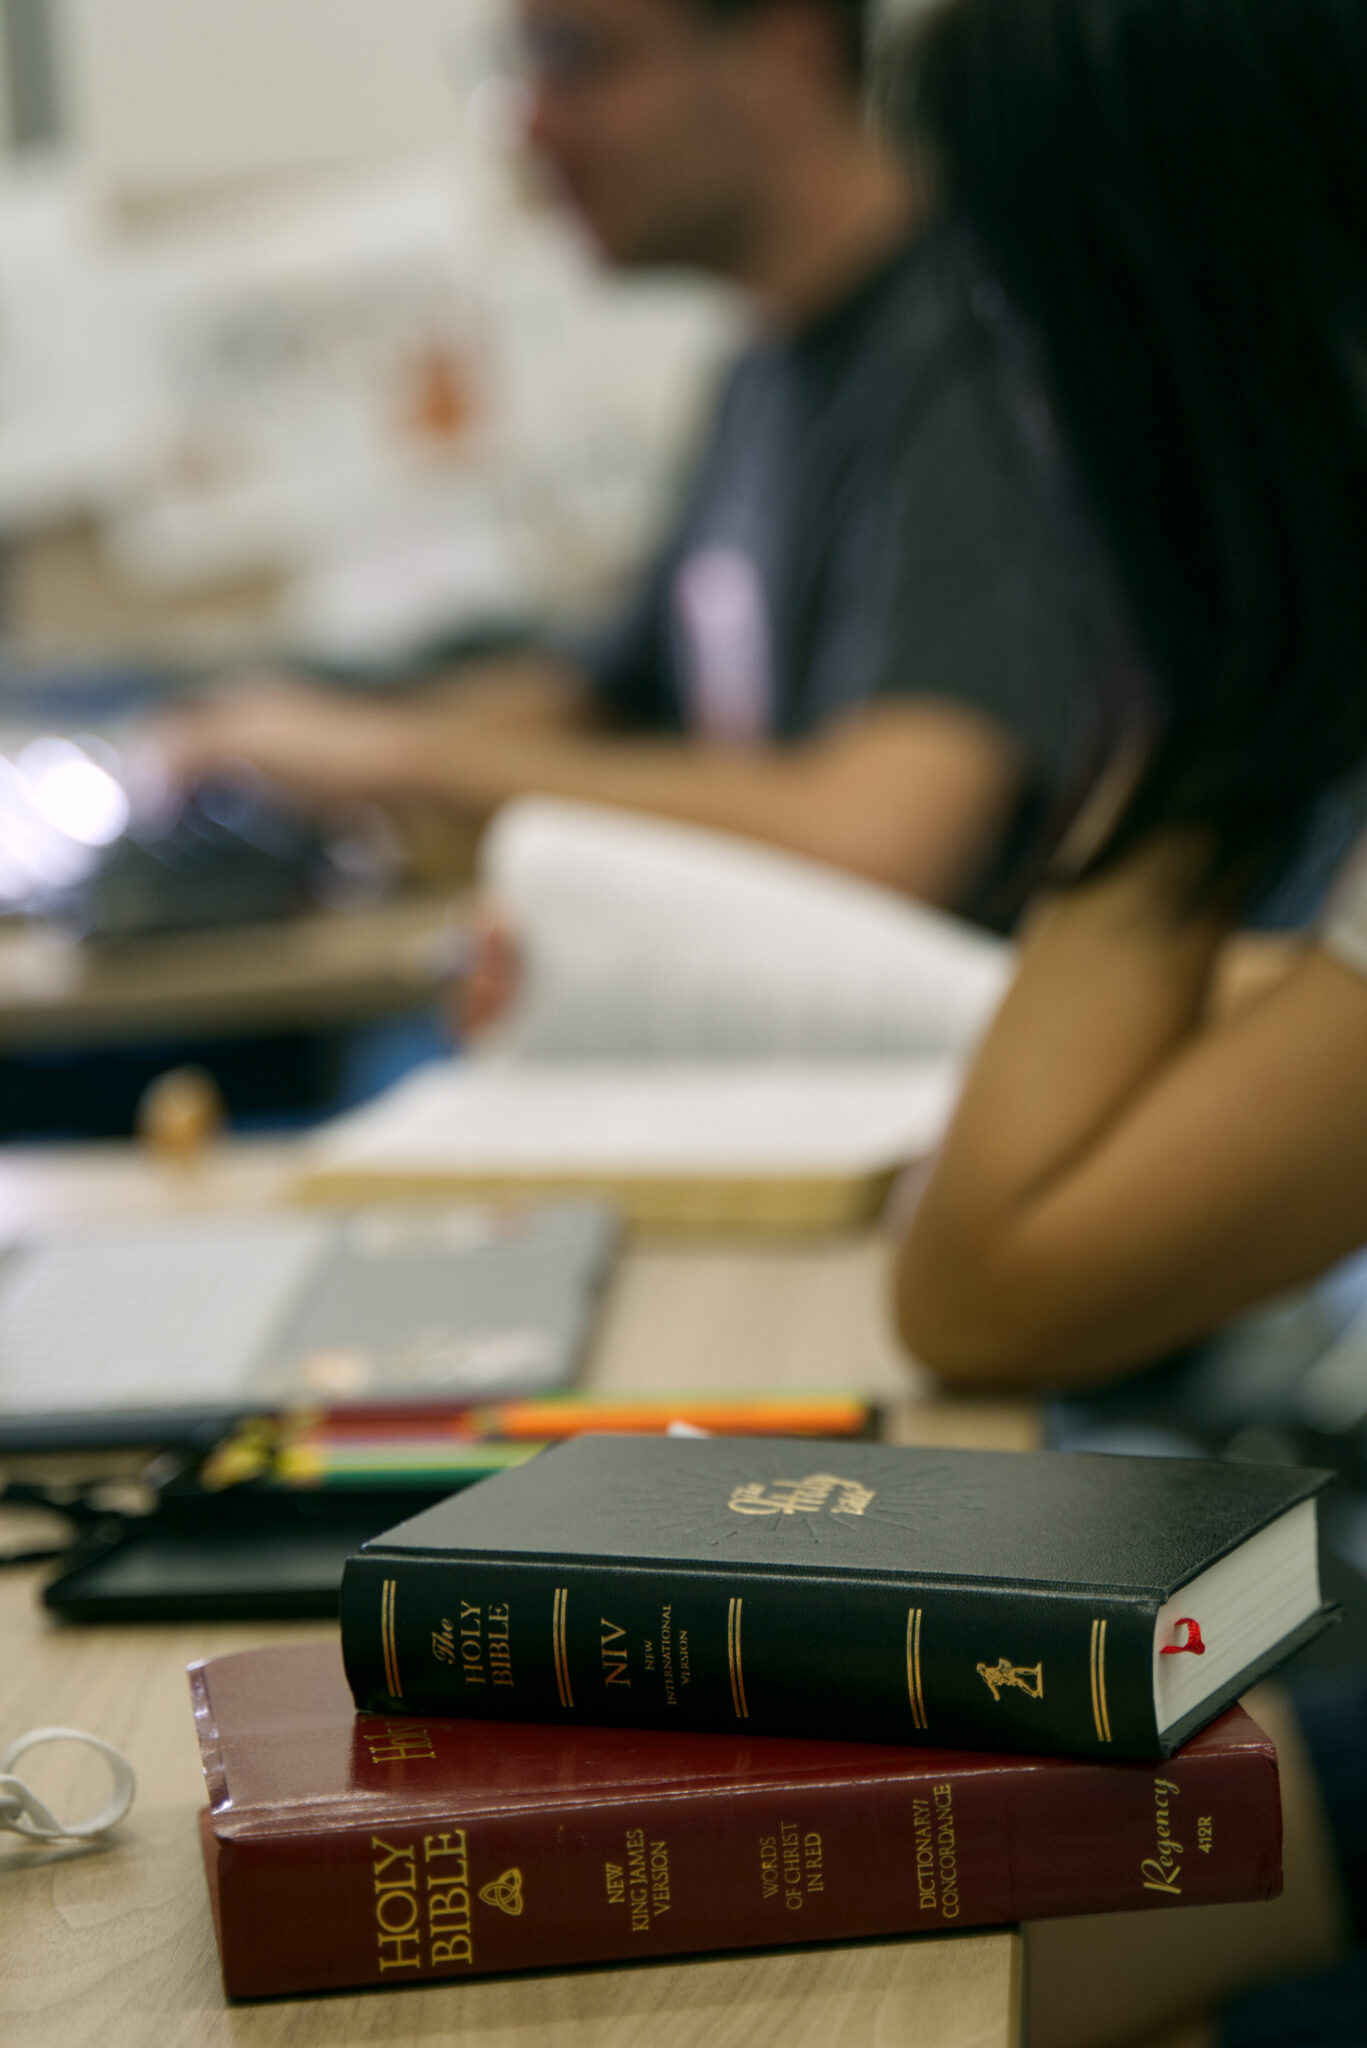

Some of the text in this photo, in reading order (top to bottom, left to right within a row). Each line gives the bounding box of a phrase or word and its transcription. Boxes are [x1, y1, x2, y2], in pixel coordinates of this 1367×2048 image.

[432, 1617, 455, 1665] The
[460, 1600, 486, 1685] HOLY
[488, 1602, 514, 1687] BIBLE
[600, 1617, 631, 1688] NIV
[644, 1639, 655, 1671] NEW
[661, 1603, 678, 1705] INTERNATIONAL
[679, 1629, 691, 1685] VERSION
[760, 1836, 779, 1899] WORDS
[780, 1821, 803, 1910] OF CHRIST
[804, 1832, 825, 1892] IN RED
[933, 1783, 960, 1918] CONCORDANCE
[1141, 1778, 1184, 1895] Regency
[1197, 1815, 1213, 1854] 412R
[372, 1836, 421, 1973] HOLY
[424, 1828, 472, 1967] BIBLE
[605, 1862, 625, 1904] NEW
[626, 1828, 649, 1932] KING JAMES
[650, 1841, 671, 1916] VERSION
